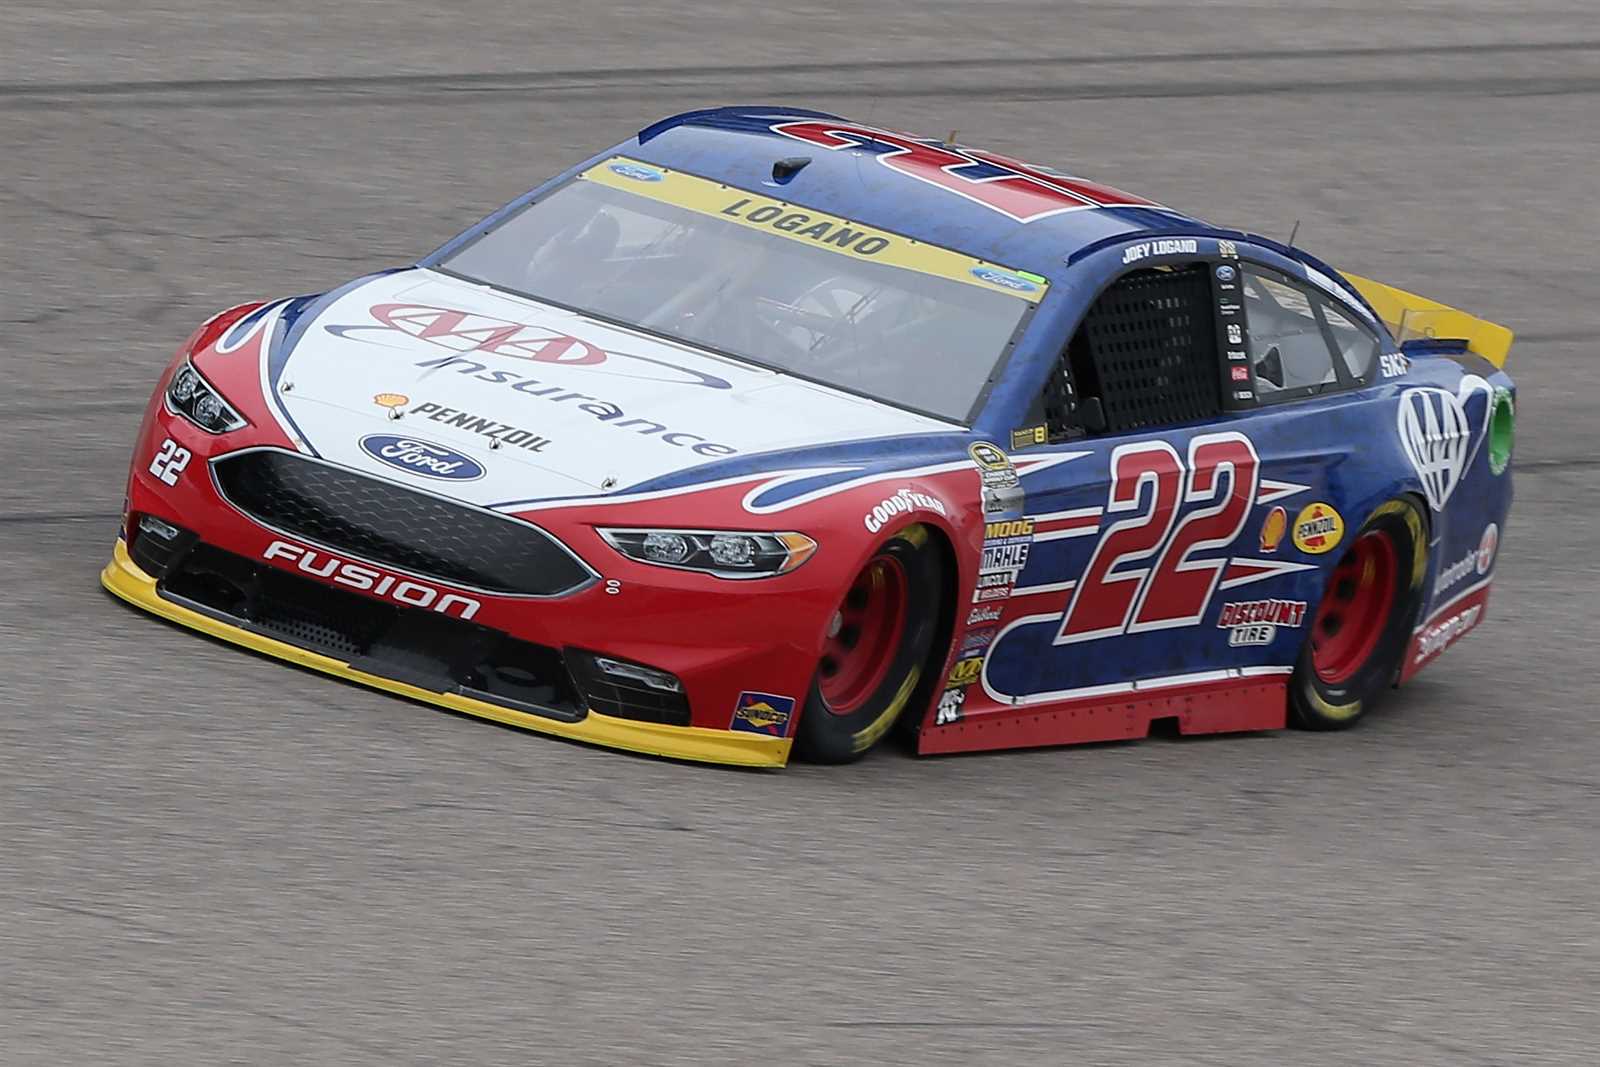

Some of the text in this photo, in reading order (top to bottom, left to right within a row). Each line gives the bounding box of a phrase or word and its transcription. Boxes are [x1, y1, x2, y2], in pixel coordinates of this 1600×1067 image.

[720, 198, 890, 256] LOGANO
[1122, 242, 1150, 265] JOEY
[1152, 239, 1198, 255] LOGANO
[369, 303, 608, 366] AAA
[1379, 352, 1411, 378] SKF
[408, 401, 555, 454] PENNZOIL
[414, 356, 739, 458] Insurance
[148, 438, 192, 487] 22
[381, 438, 462, 477] Ford
[863, 487, 947, 534] GOODYEAR
[984, 520, 1034, 540] MOOG
[982, 543, 1029, 569] MAHLE
[1051, 431, 1261, 646] 22
[263, 540, 482, 621] FUSION
[1216, 598, 1308, 629] DISCOUNT
[1233, 626, 1270, 643] TIRE
